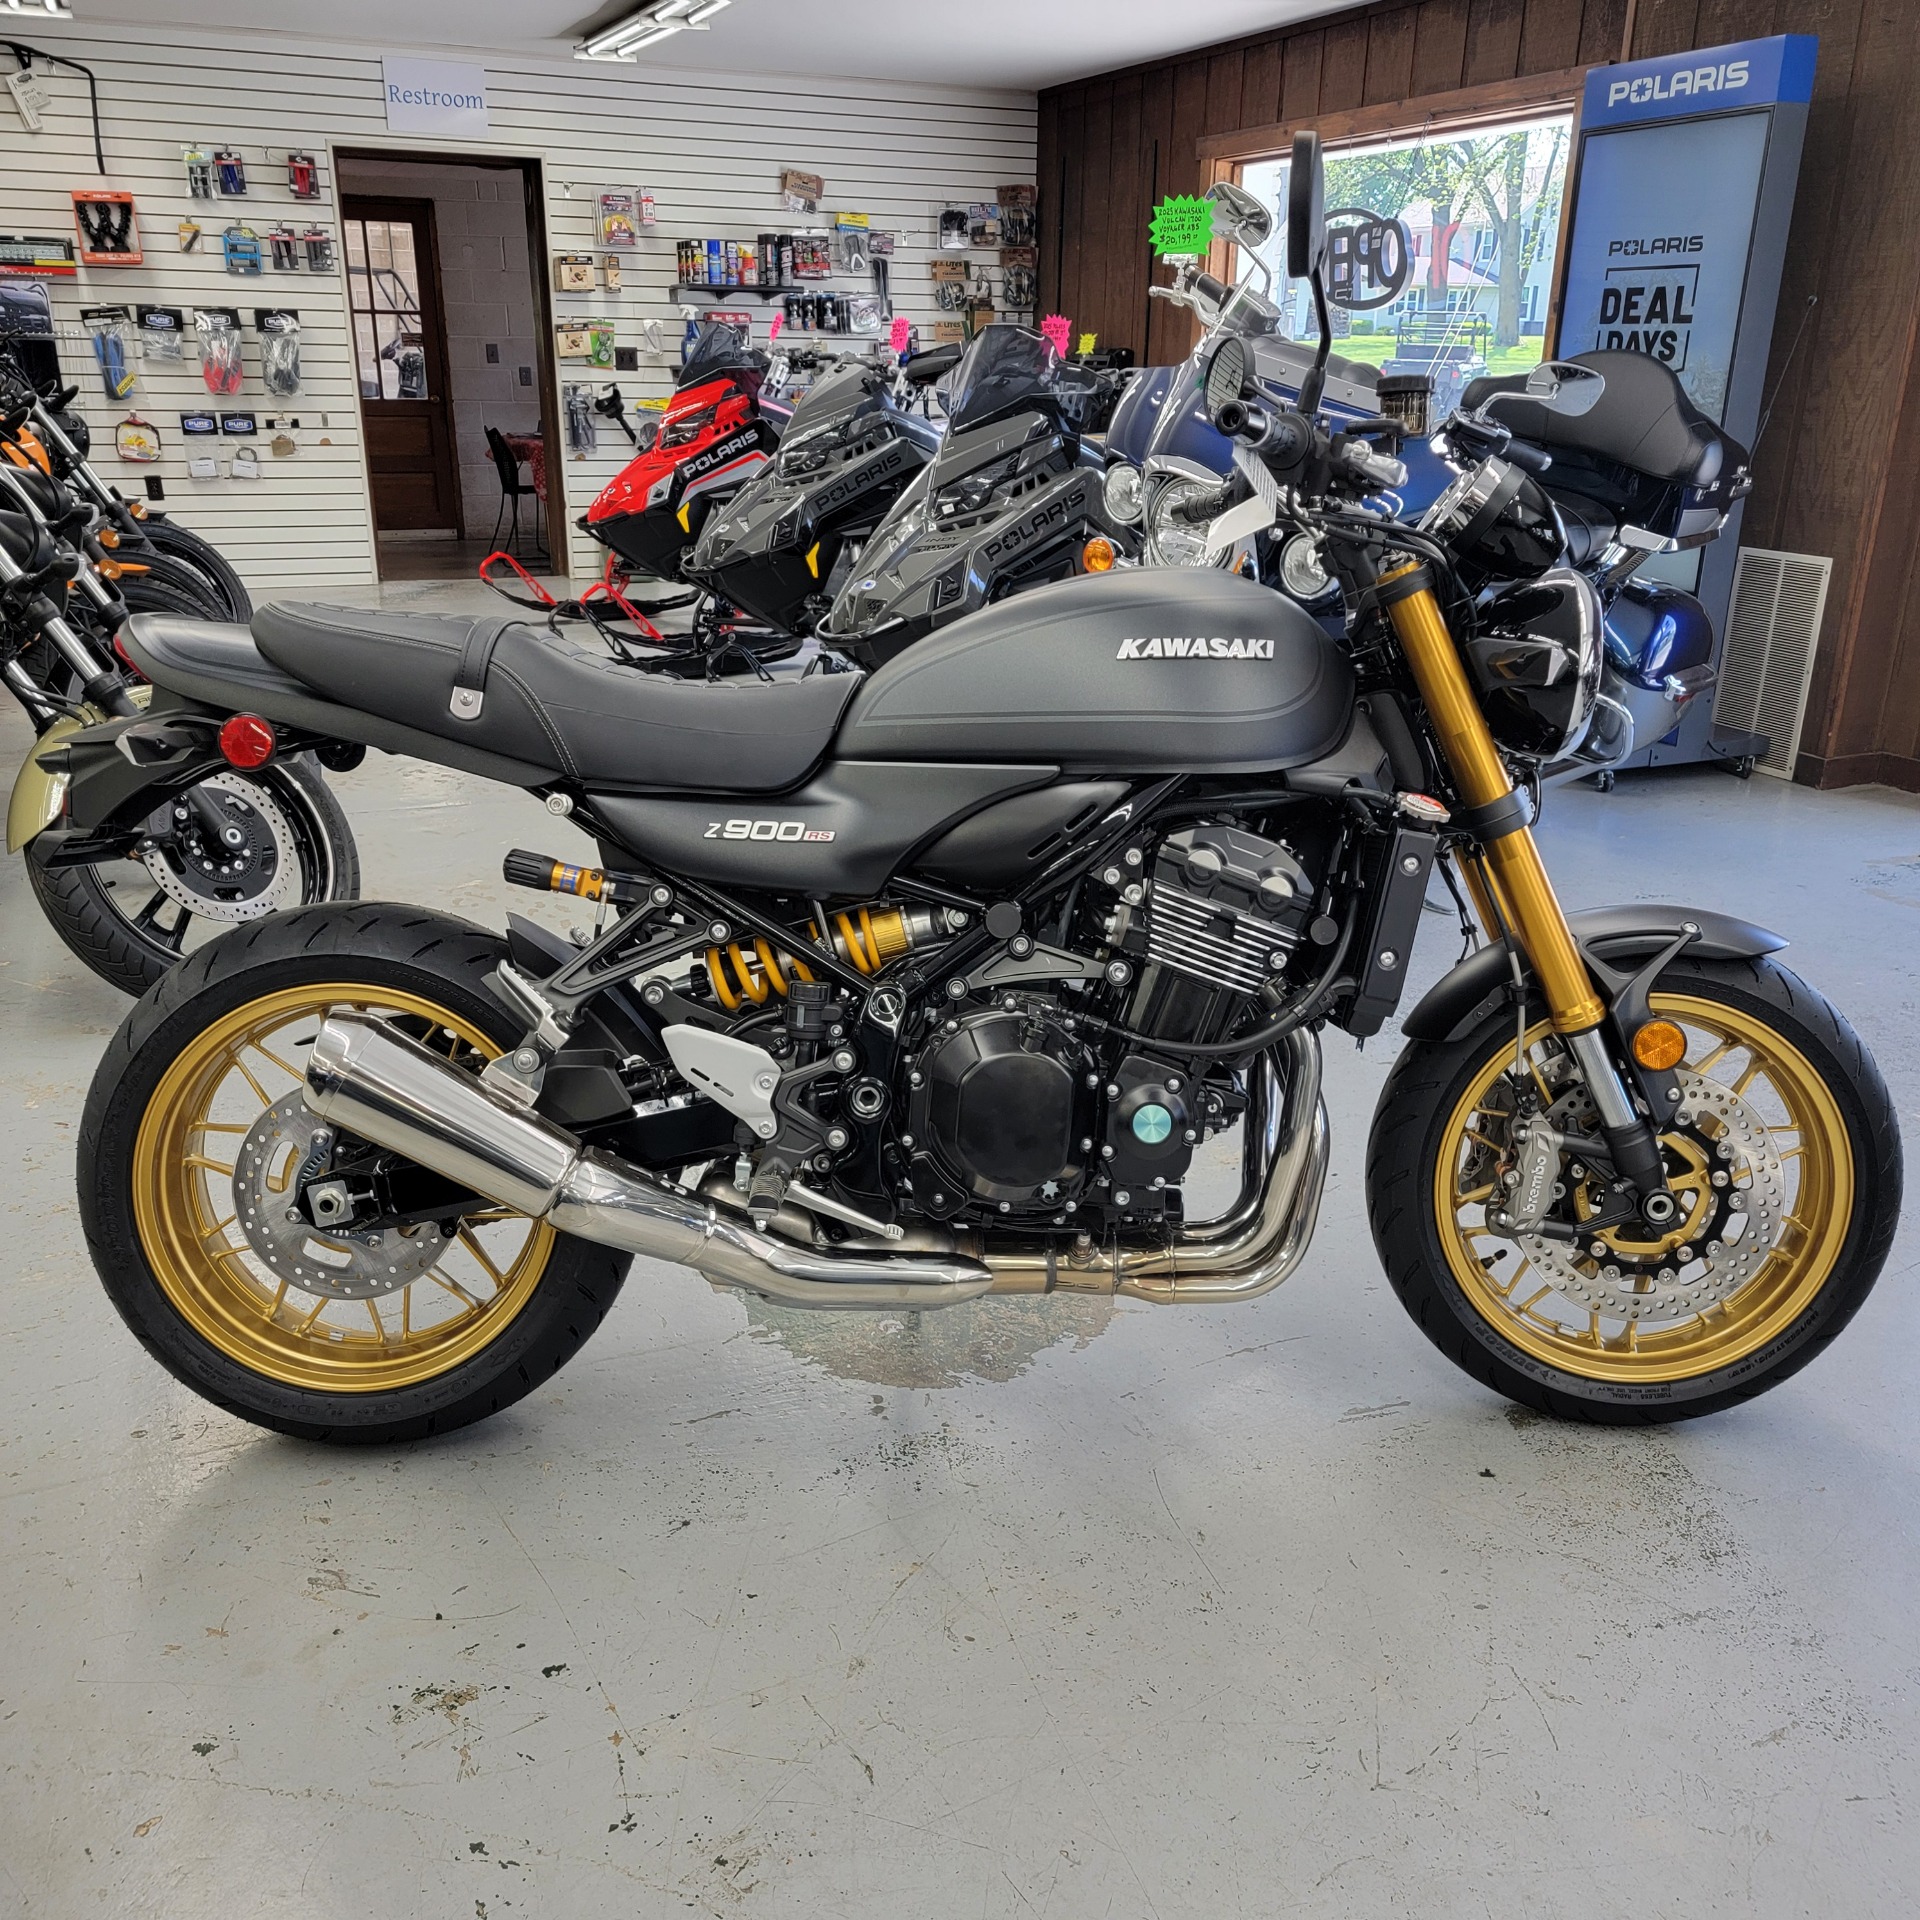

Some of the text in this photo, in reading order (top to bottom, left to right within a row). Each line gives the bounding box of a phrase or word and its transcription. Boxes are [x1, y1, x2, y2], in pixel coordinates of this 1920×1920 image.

[387, 84, 484, 109] Restroom
[1608, 60, 1750, 108] POLARIS
[1158, 205, 1206, 217] 2025 KAWASAKI
[1161, 215, 1202, 224] VULCAN 1700
[1158, 222, 1200, 234] VOYAGER ABS
[1608, 235, 1704, 256] POLARIS
[1598, 285, 1694, 324] DEAL
[1605, 330, 1678, 362] DAYS
[682, 428, 759, 478] POLARIS
[815, 452, 902, 511] POLARIS
[925, 535, 961, 543] INDY
[984, 487, 1086, 562] POLARIS
[1116, 637, 1275, 660] KAWASAKI
[1522, 1155, 1547, 1214] brembo
[1475, 1326, 1540, 1373] DUNLOP
